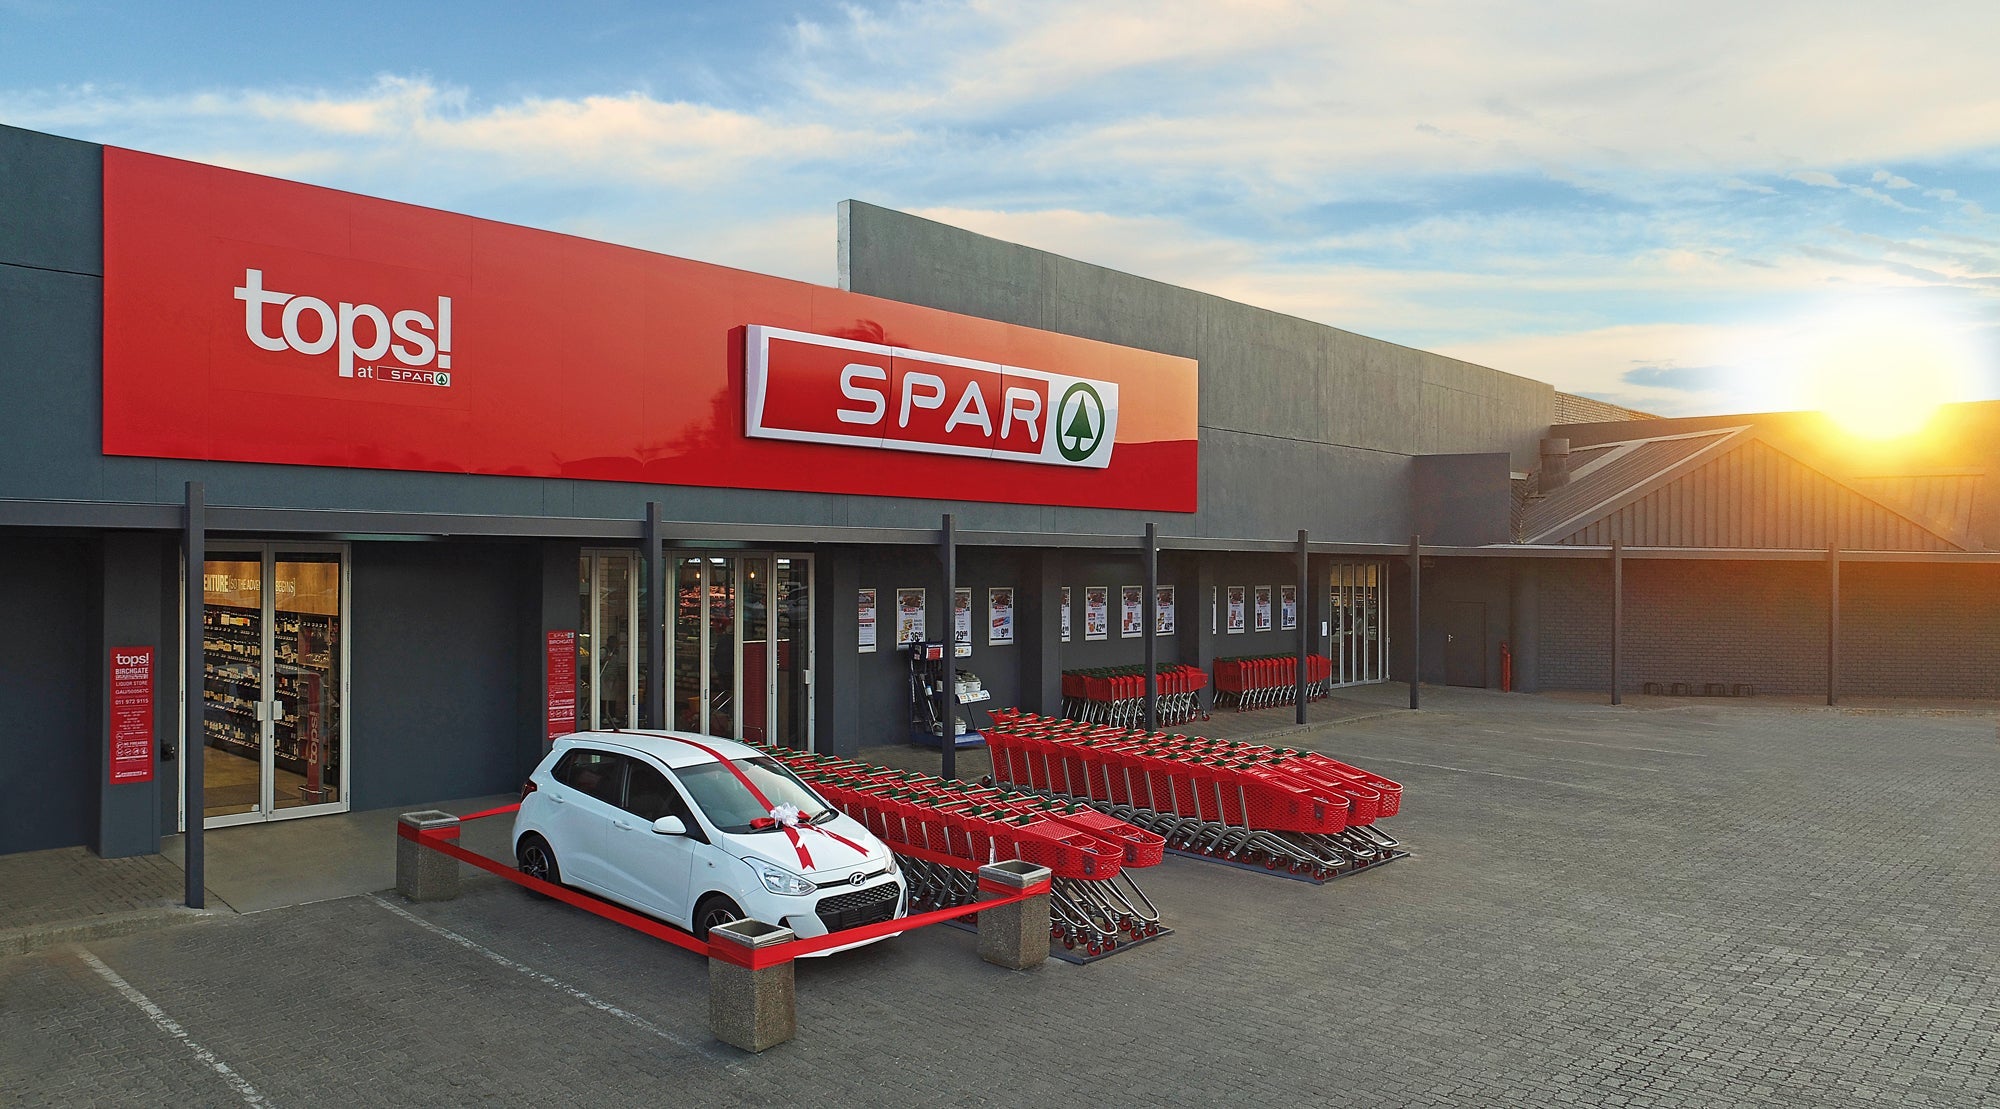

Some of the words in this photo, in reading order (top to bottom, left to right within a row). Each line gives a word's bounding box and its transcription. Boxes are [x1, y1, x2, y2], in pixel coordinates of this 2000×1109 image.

[233, 268, 452, 378] tops!
[357, 365, 374, 379] at
[391, 370, 433, 383] SPAR
[836, 363, 1042, 443] SPAR
[116, 652, 149, 667] tops!
[115, 667, 149, 675] BIRCHGATE
